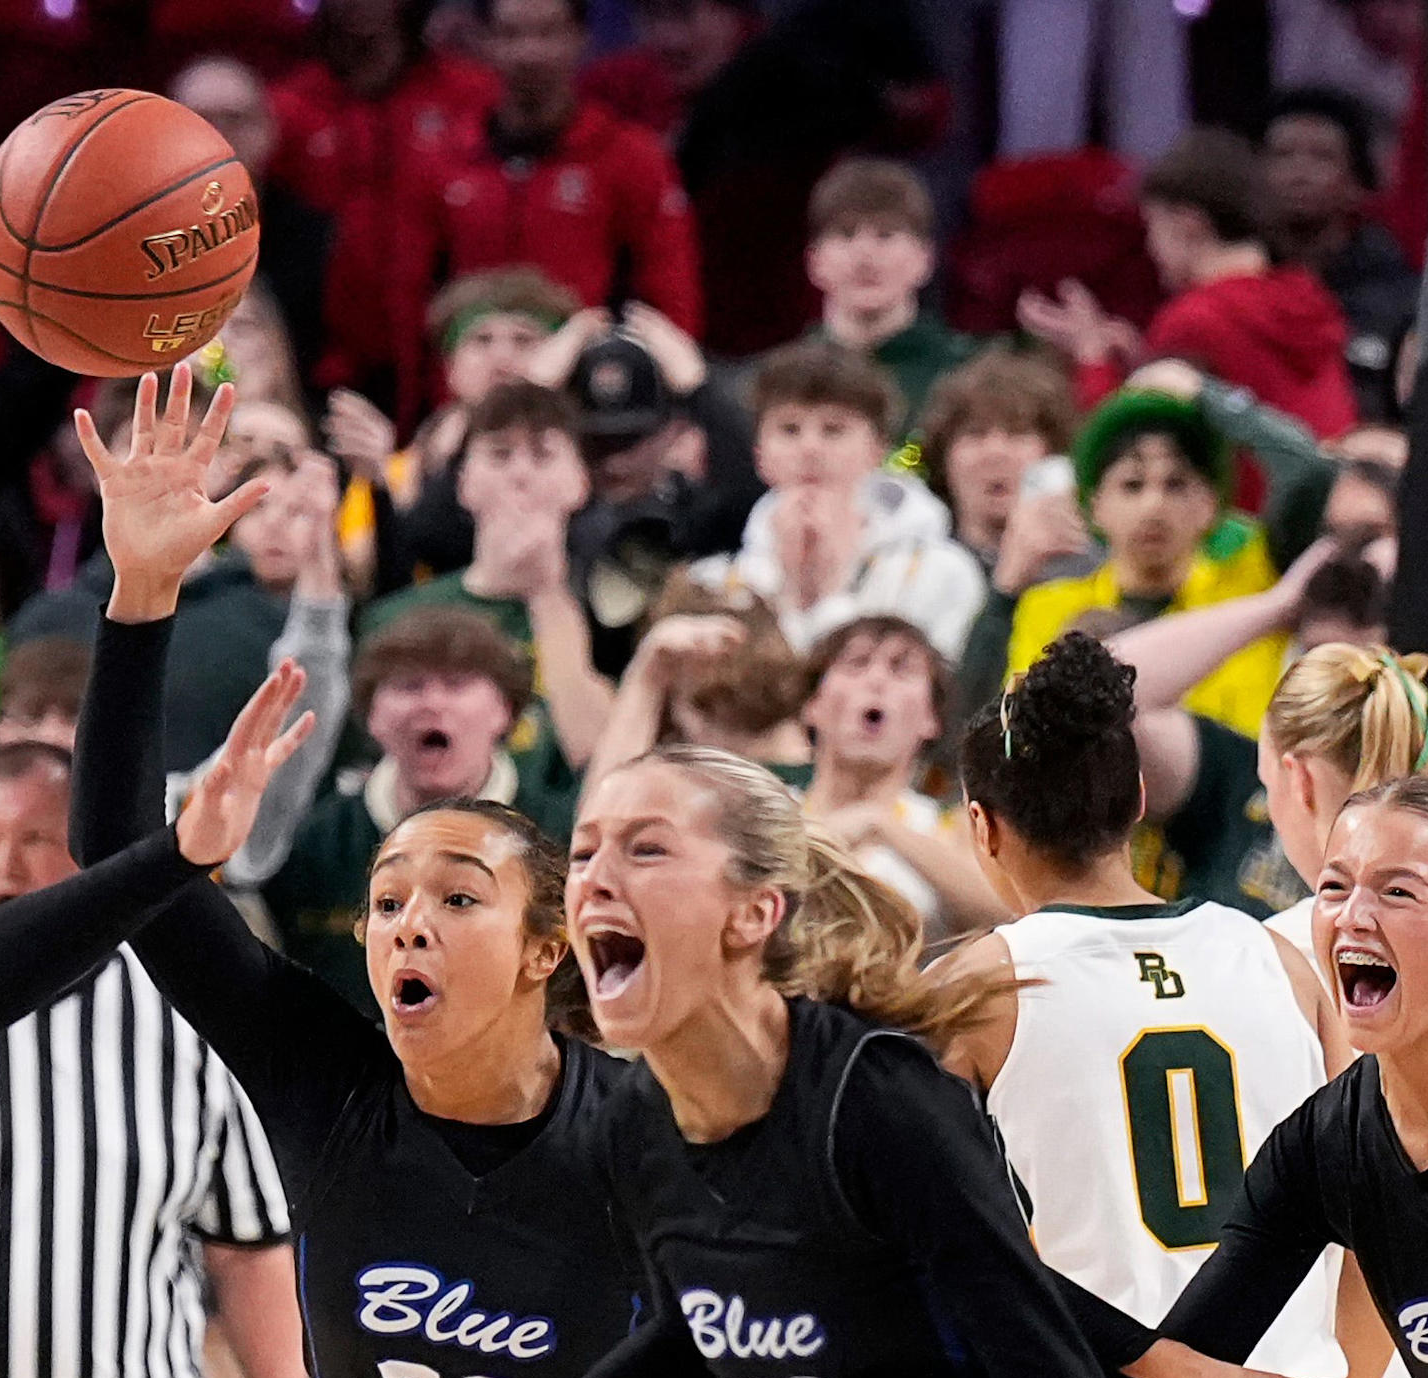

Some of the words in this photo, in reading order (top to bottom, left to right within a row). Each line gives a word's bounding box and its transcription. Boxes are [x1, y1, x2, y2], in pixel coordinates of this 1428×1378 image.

[141, 197, 258, 280] SPALDIN
[1117, 1022, 1247, 1252] 0
[358, 1266, 551, 1359] Blue
[679, 1287, 824, 1359] Blue
